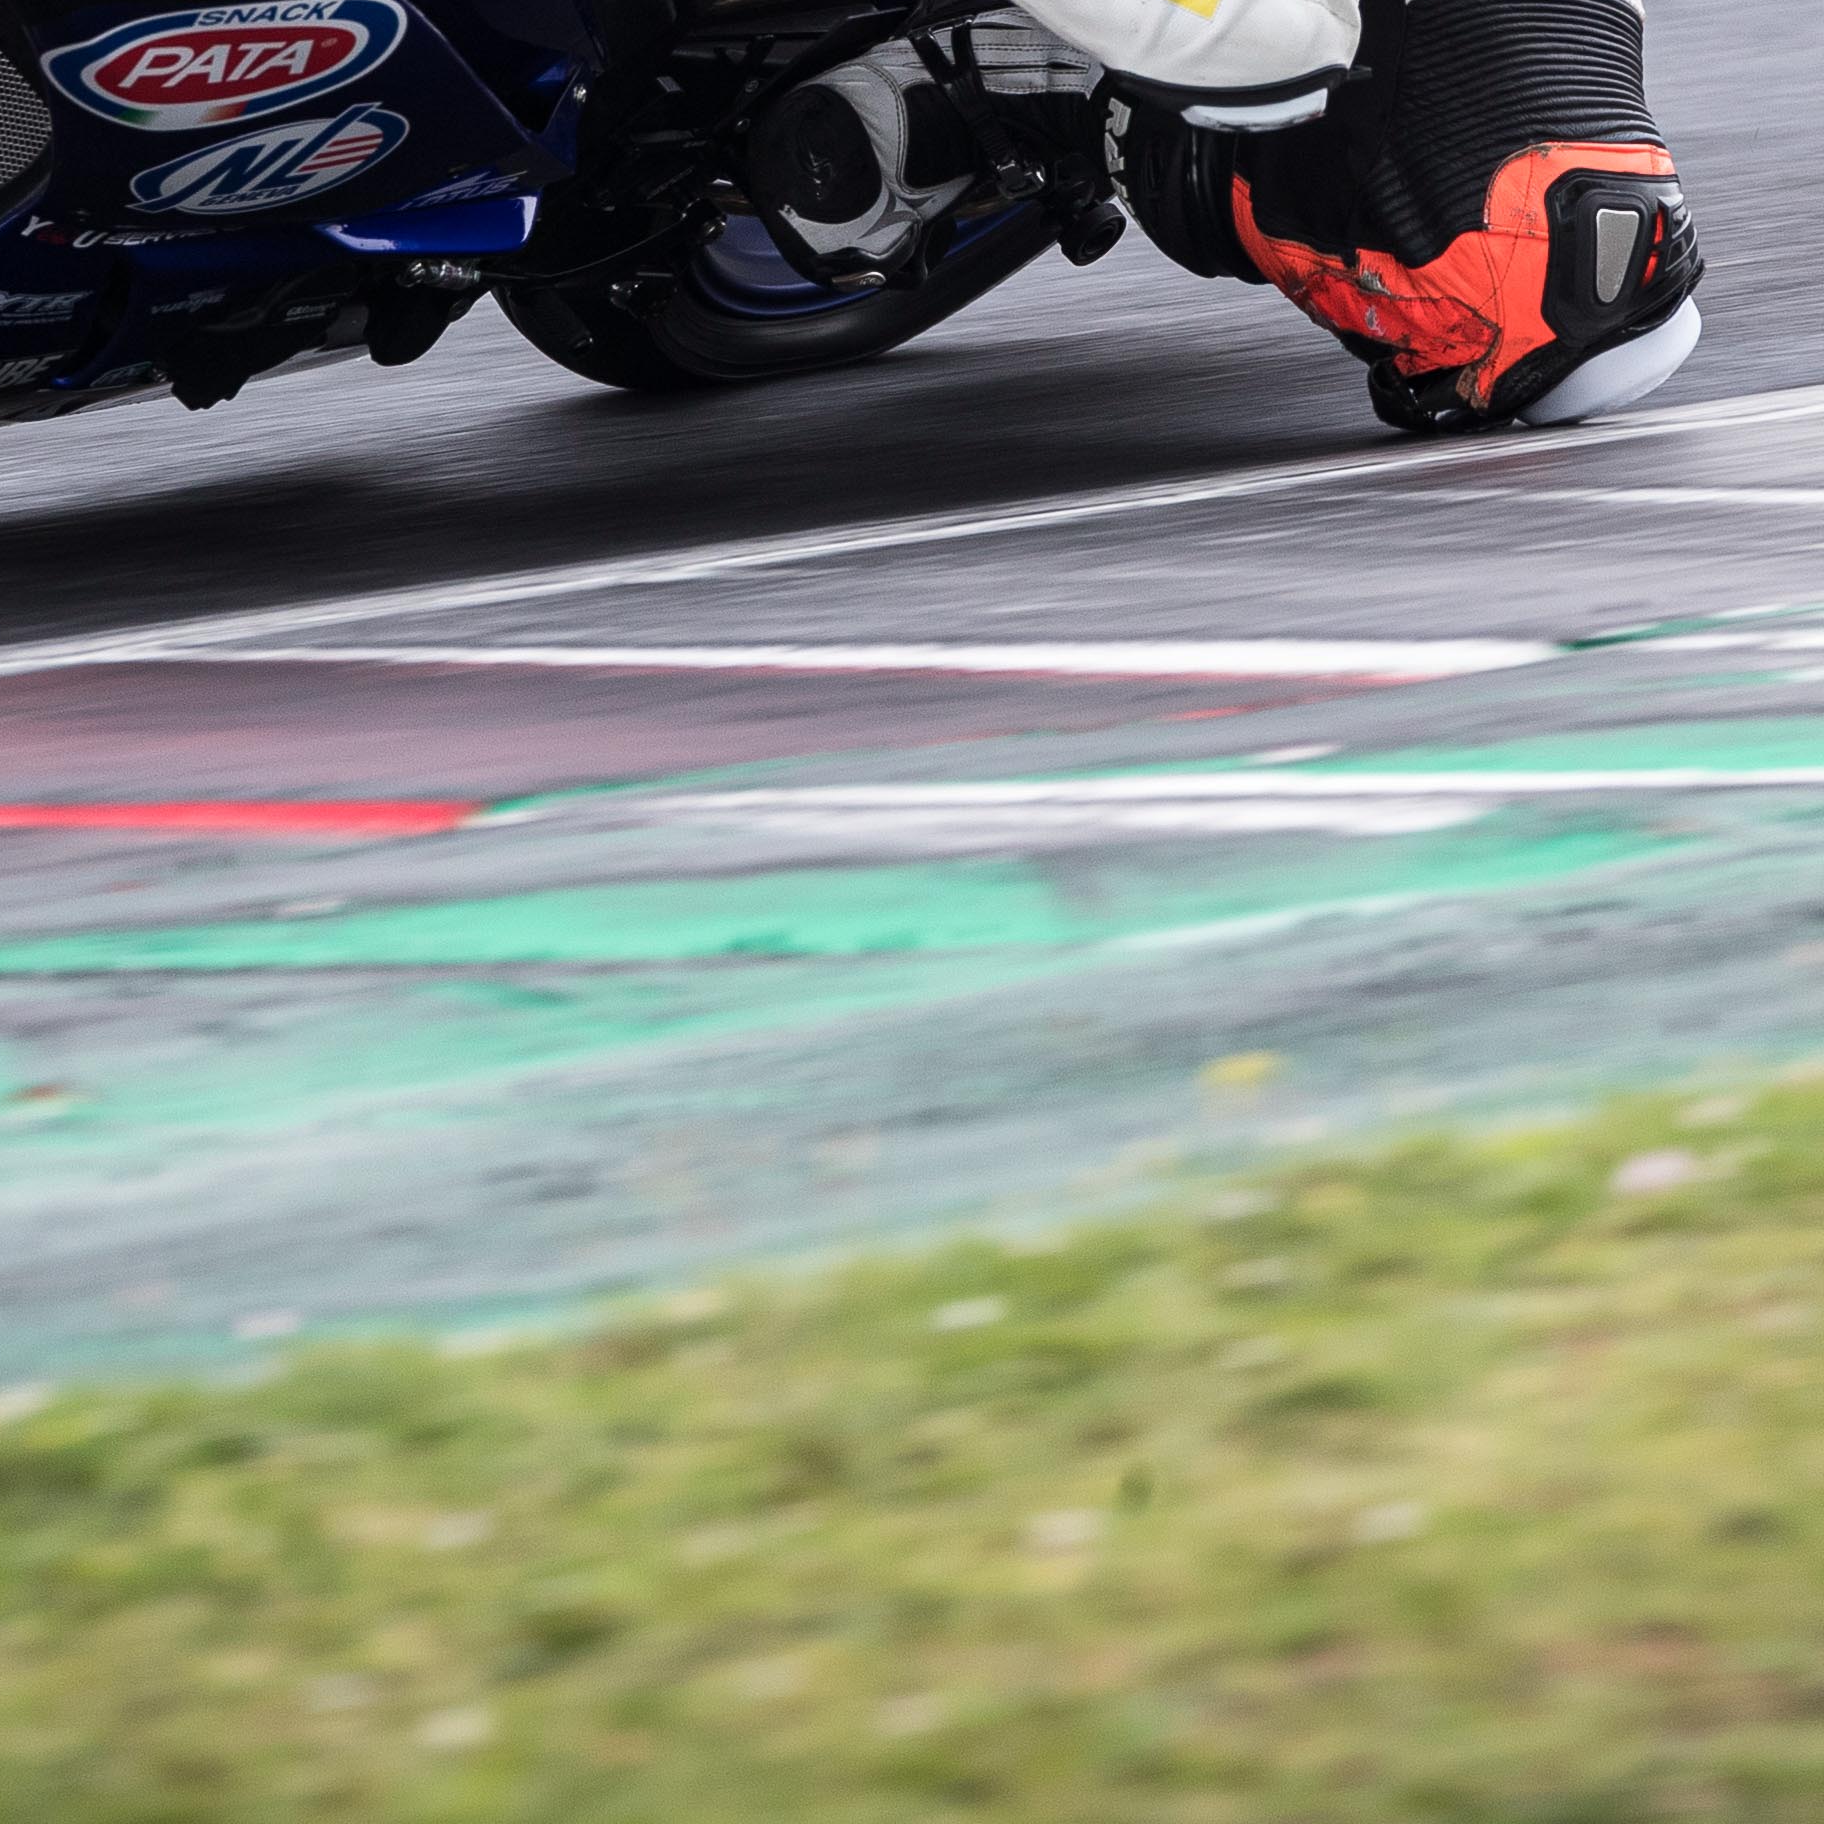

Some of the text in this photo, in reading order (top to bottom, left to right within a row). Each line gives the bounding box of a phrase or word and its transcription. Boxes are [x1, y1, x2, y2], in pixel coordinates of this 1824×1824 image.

[196, 1, 336, 27] SNACK
[118, 39, 315, 88] PATA
[199, 184, 302, 207] GENEVA
